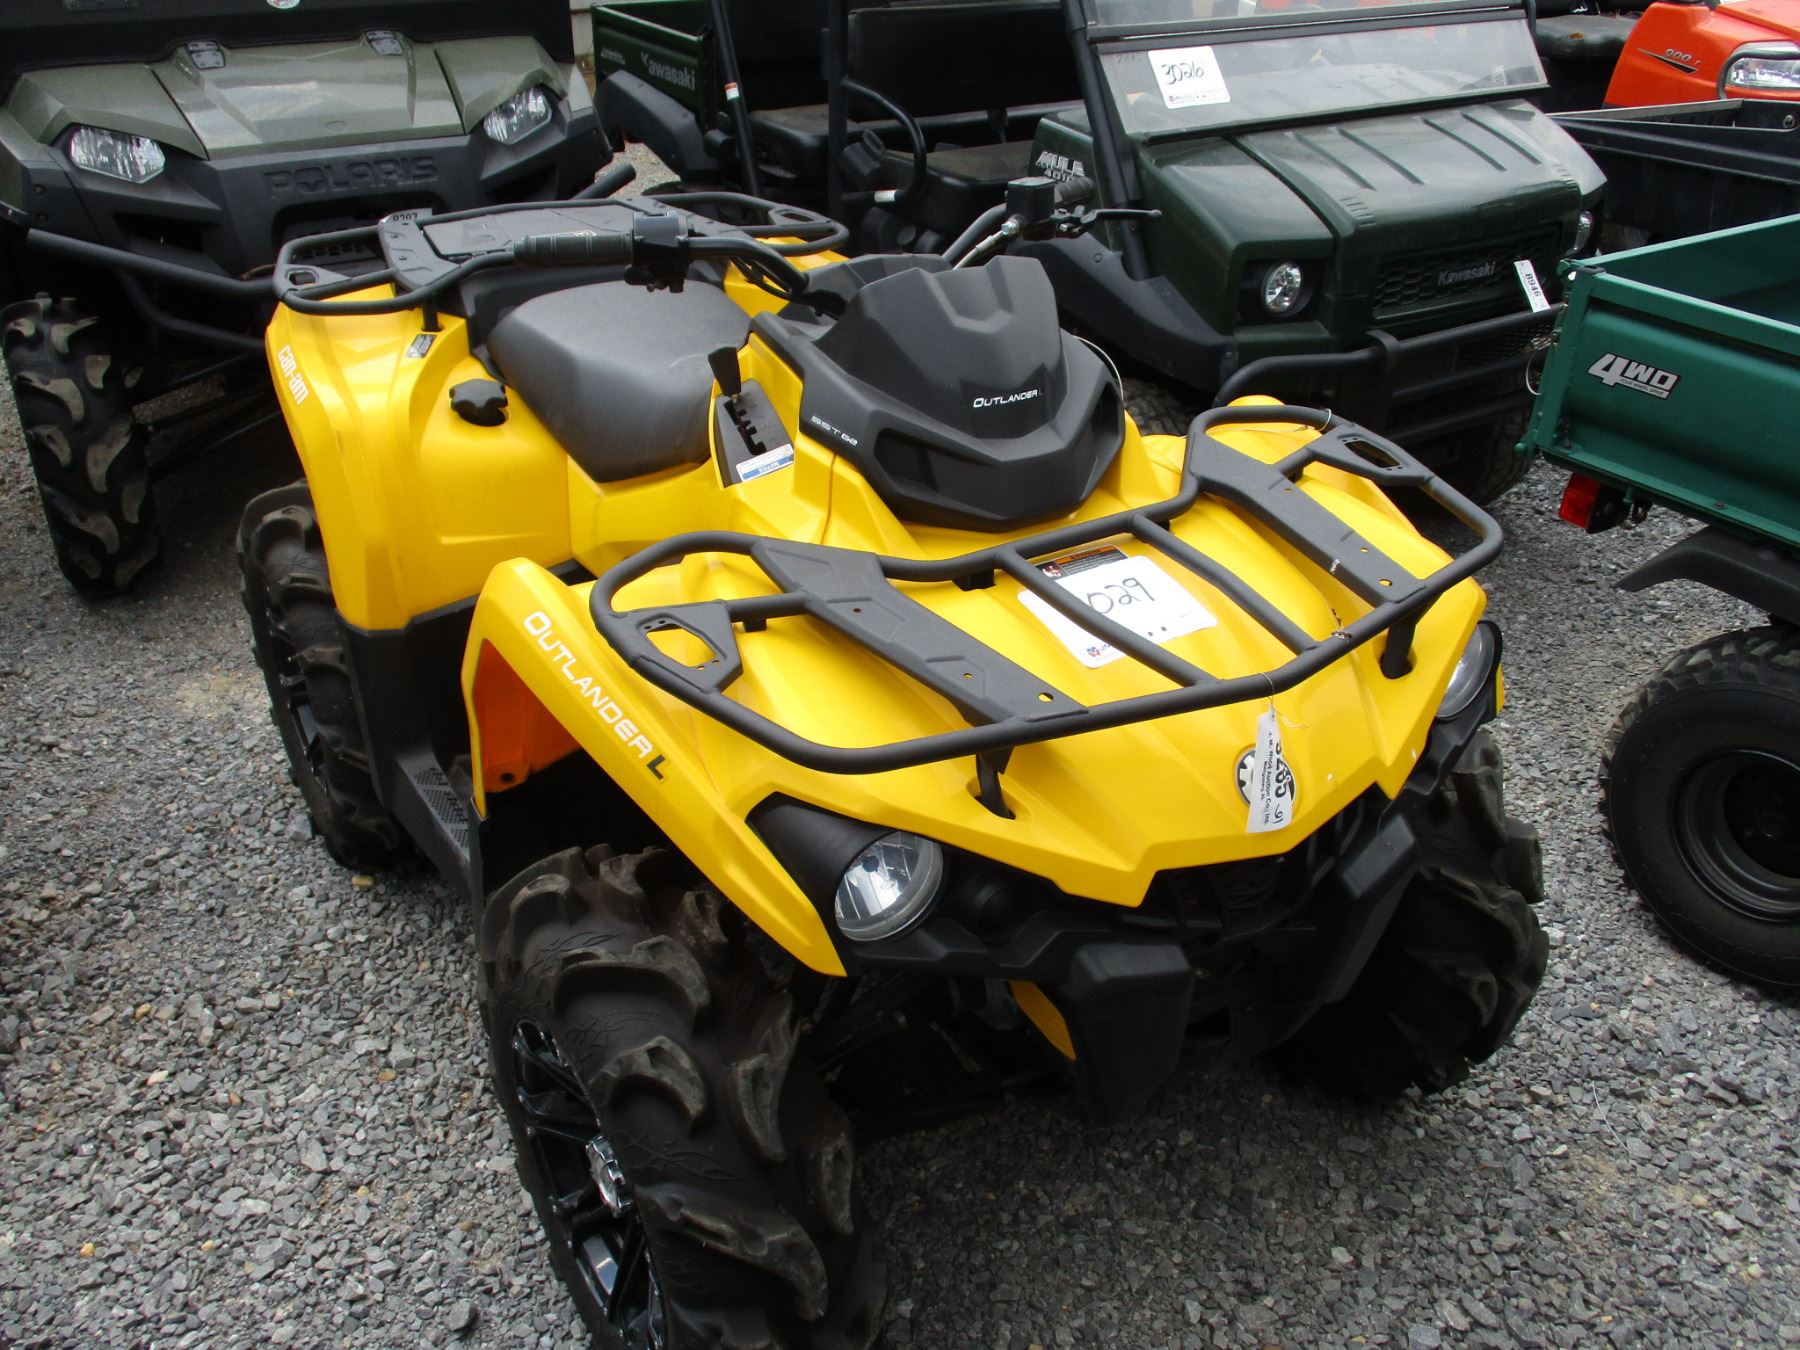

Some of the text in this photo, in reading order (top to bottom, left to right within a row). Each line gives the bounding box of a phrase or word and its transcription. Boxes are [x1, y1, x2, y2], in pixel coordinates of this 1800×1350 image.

[641, 51, 696, 90] Kawasaki
[1161, 62, 1204, 85] 3026
[264, 156, 439, 199] POLARIS
[1035, 150, 1085, 176] MULE
[1438, 261, 1496, 286] Kawasaki
[278, 344, 309, 406] can-am
[1587, 352, 1680, 390] 4WD
